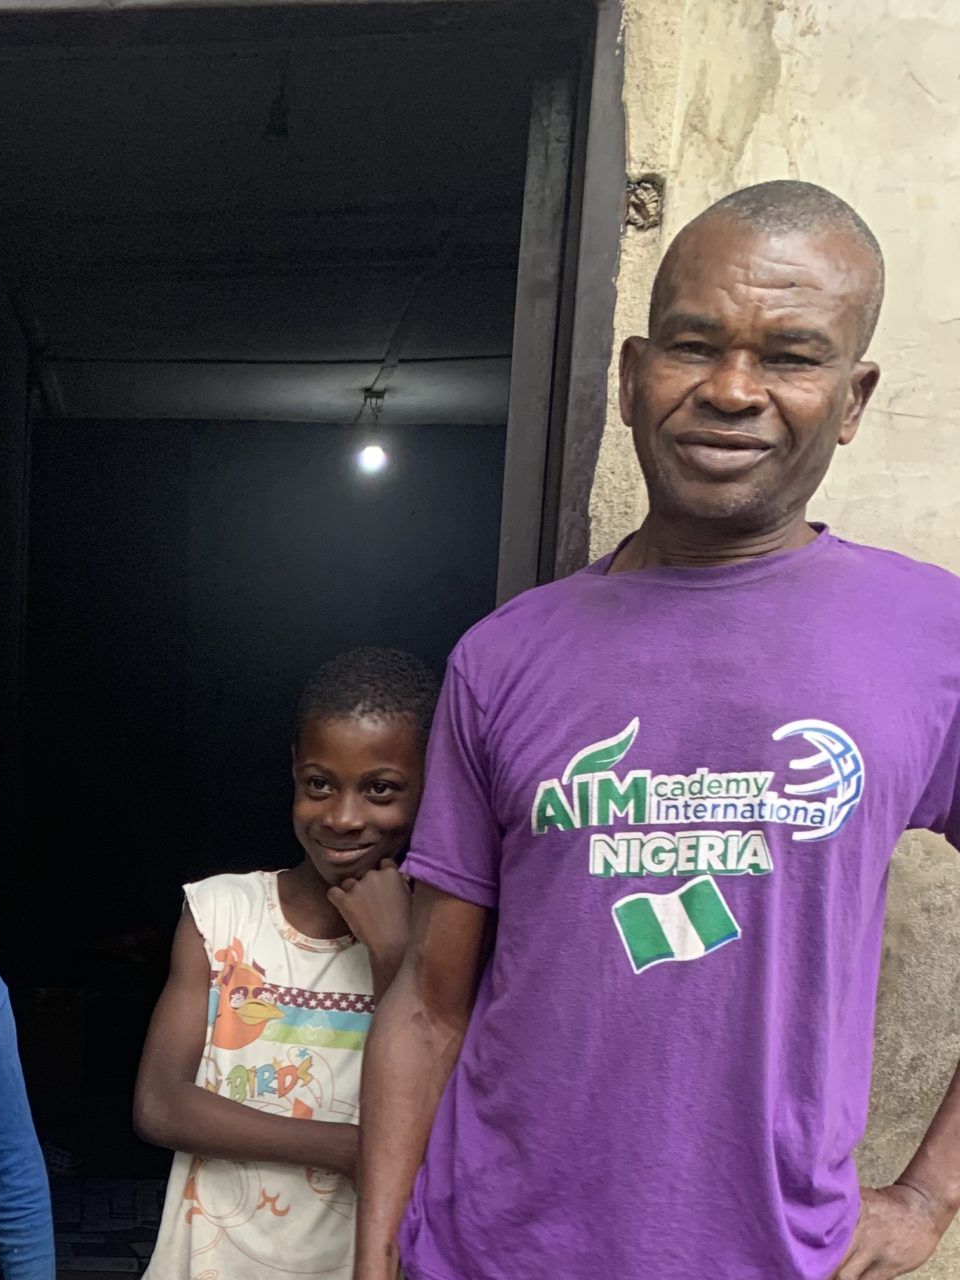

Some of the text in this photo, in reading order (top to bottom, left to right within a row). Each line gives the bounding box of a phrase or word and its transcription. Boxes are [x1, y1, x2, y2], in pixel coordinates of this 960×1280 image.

[533, 772, 769, 834] AIM cademy
[656, 799, 834, 827] International
[591, 834, 772, 874] NIGERIA
[226, 1056, 313, 1103] BIRDS
